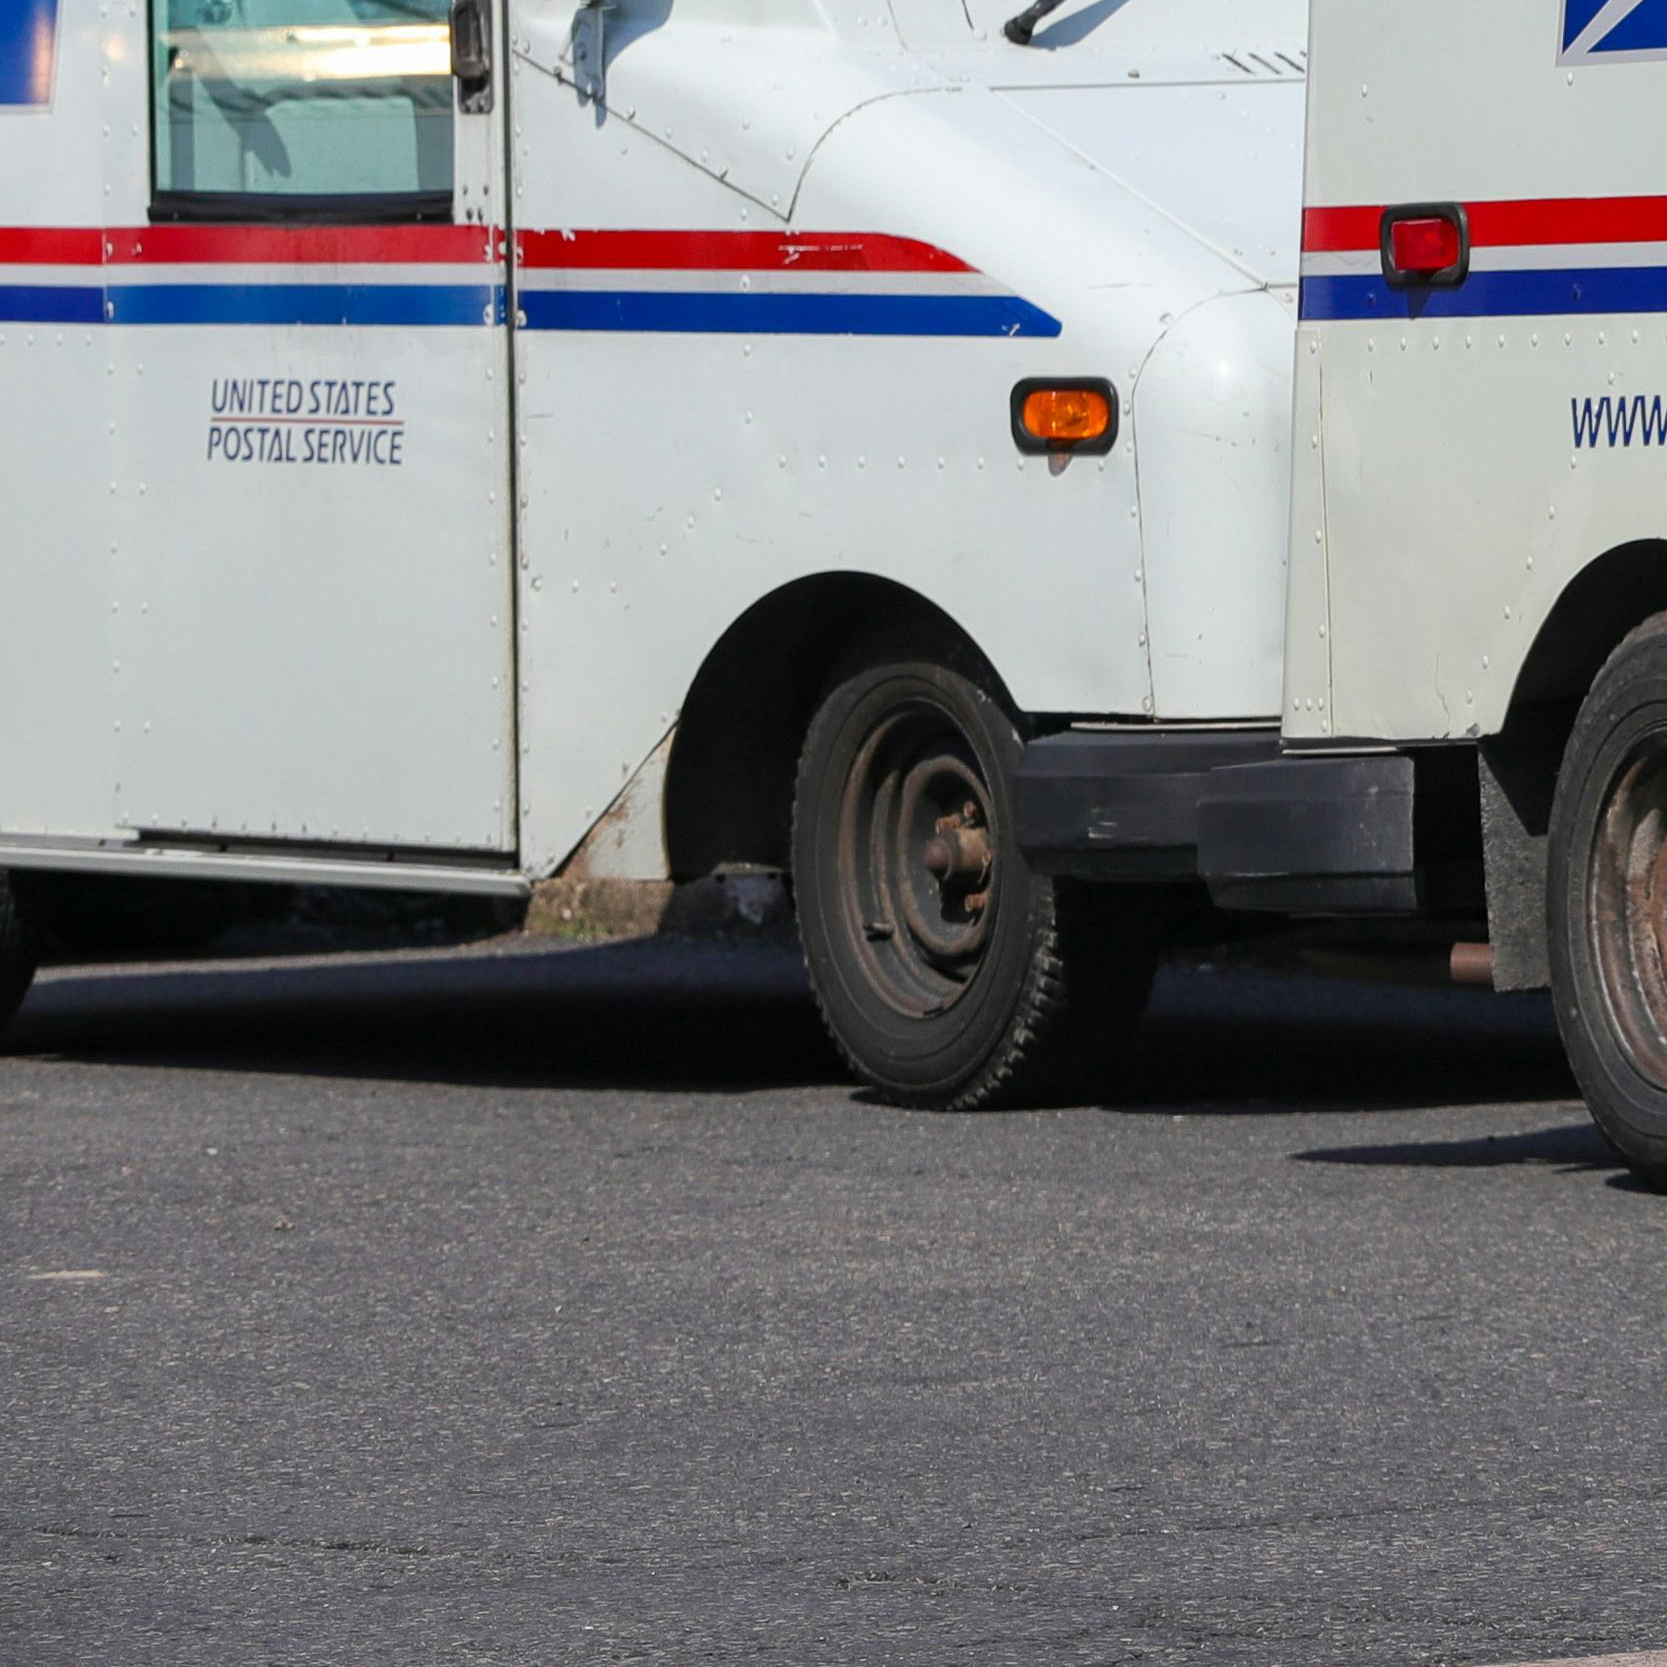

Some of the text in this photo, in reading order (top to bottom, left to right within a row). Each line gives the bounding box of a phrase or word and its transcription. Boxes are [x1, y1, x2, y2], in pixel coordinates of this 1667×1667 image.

[211, 378, 396, 416] UNITED STATES
[207, 426, 405, 466] POSTAL SERVICE
